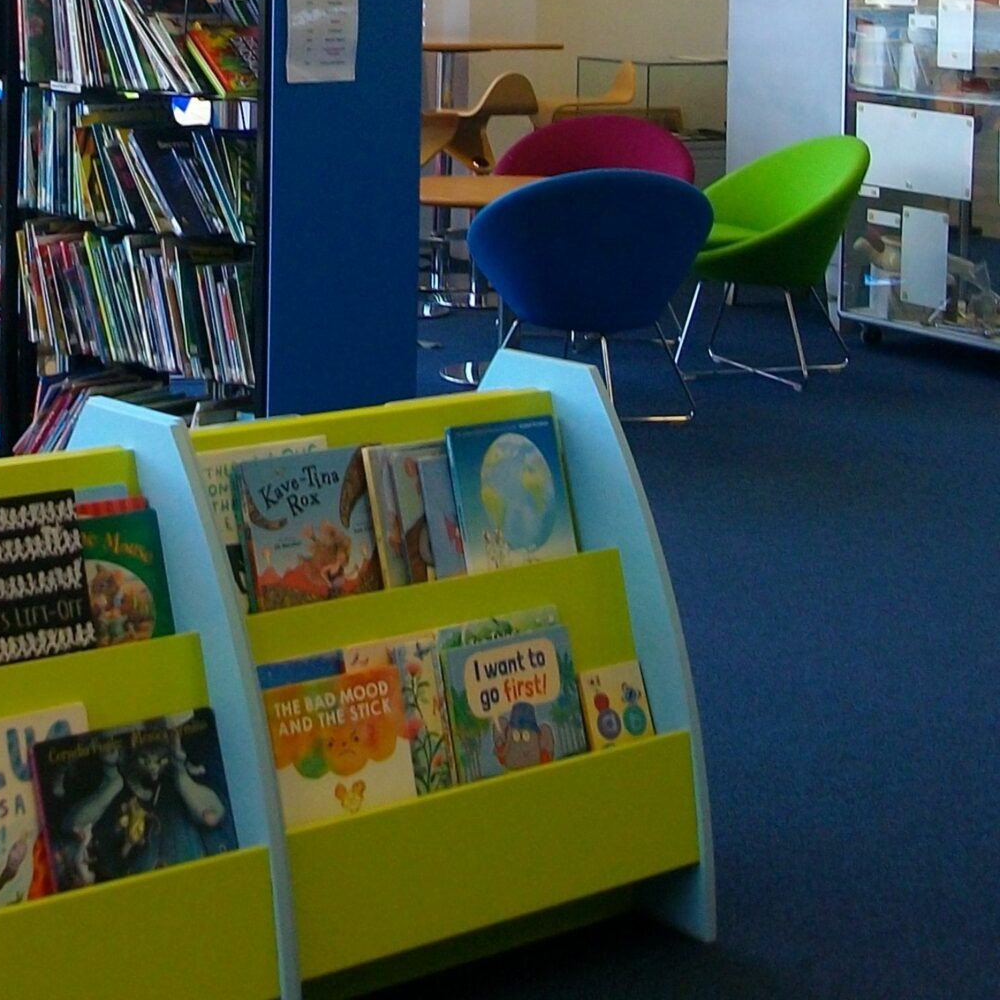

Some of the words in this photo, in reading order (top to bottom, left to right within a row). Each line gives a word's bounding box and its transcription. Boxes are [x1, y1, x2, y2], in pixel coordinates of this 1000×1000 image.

[259, 464, 340, 510] Kave-Tina
[287, 491, 322, 518] Rox
[15, 597, 84, 626] LIFT-OFF
[473, 660, 480, 682] I
[484, 651, 526, 681] want
[529, 647, 546, 668] to
[274, 699, 302, 719] THE
[304, 692, 336, 712] BAD
[339, 680, 389, 703] MOOD
[479, 683, 500, 712] go
[503, 674, 548, 704] first!
[278, 717, 313, 737] AND
[318, 709, 346, 729] THE
[349, 697, 393, 722] STICK
[14, 793, 26, 816] A
